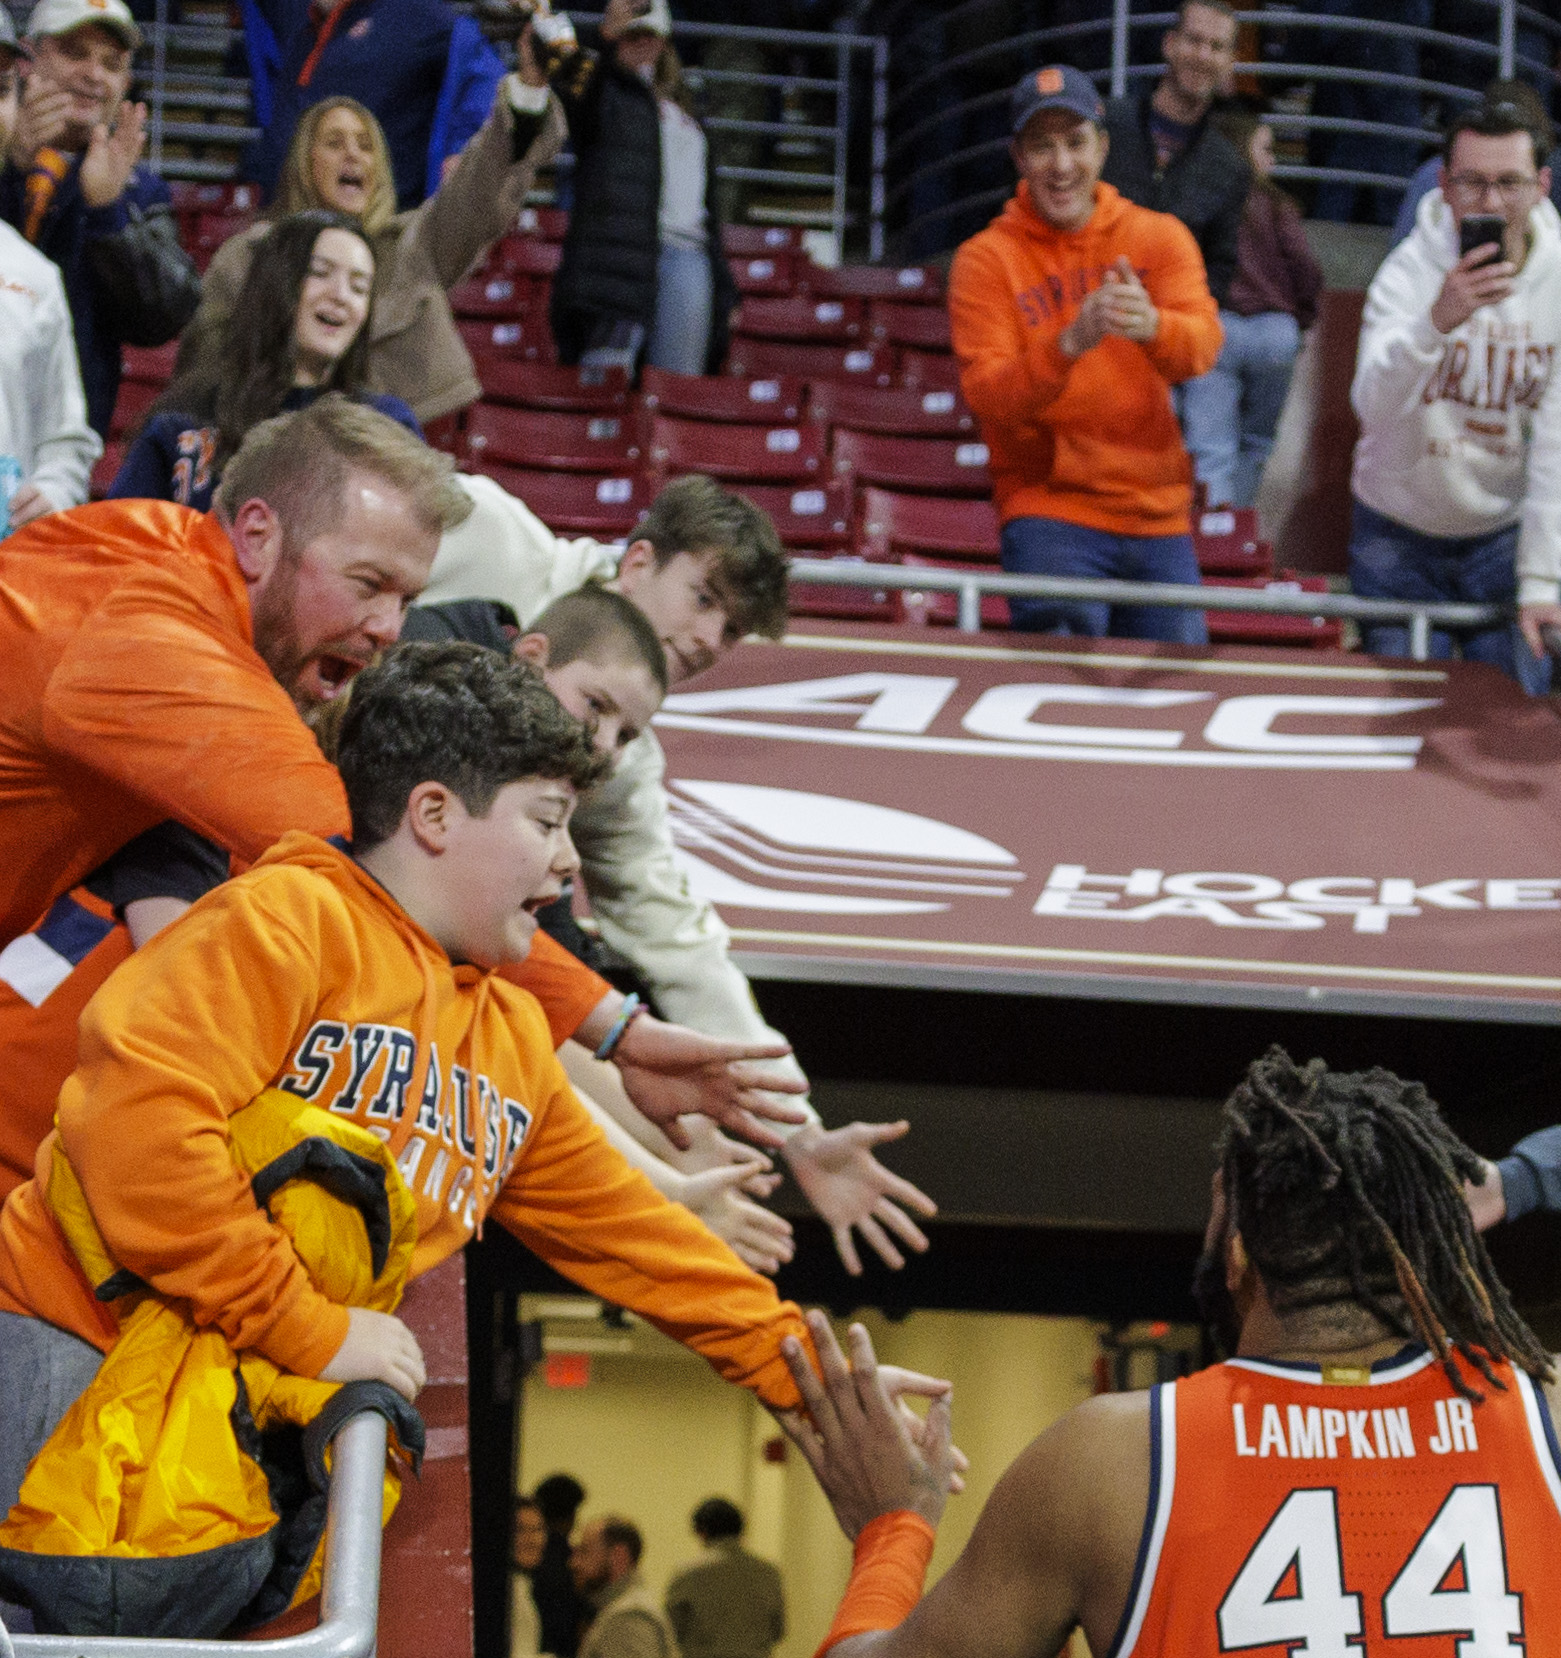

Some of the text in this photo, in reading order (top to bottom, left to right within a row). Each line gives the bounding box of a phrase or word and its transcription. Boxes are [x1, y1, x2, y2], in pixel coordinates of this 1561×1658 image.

[661, 672, 1445, 754] ACC
[1033, 889, 1422, 935] EAST
[1232, 1397, 1479, 1459] LAMPKIN JR
